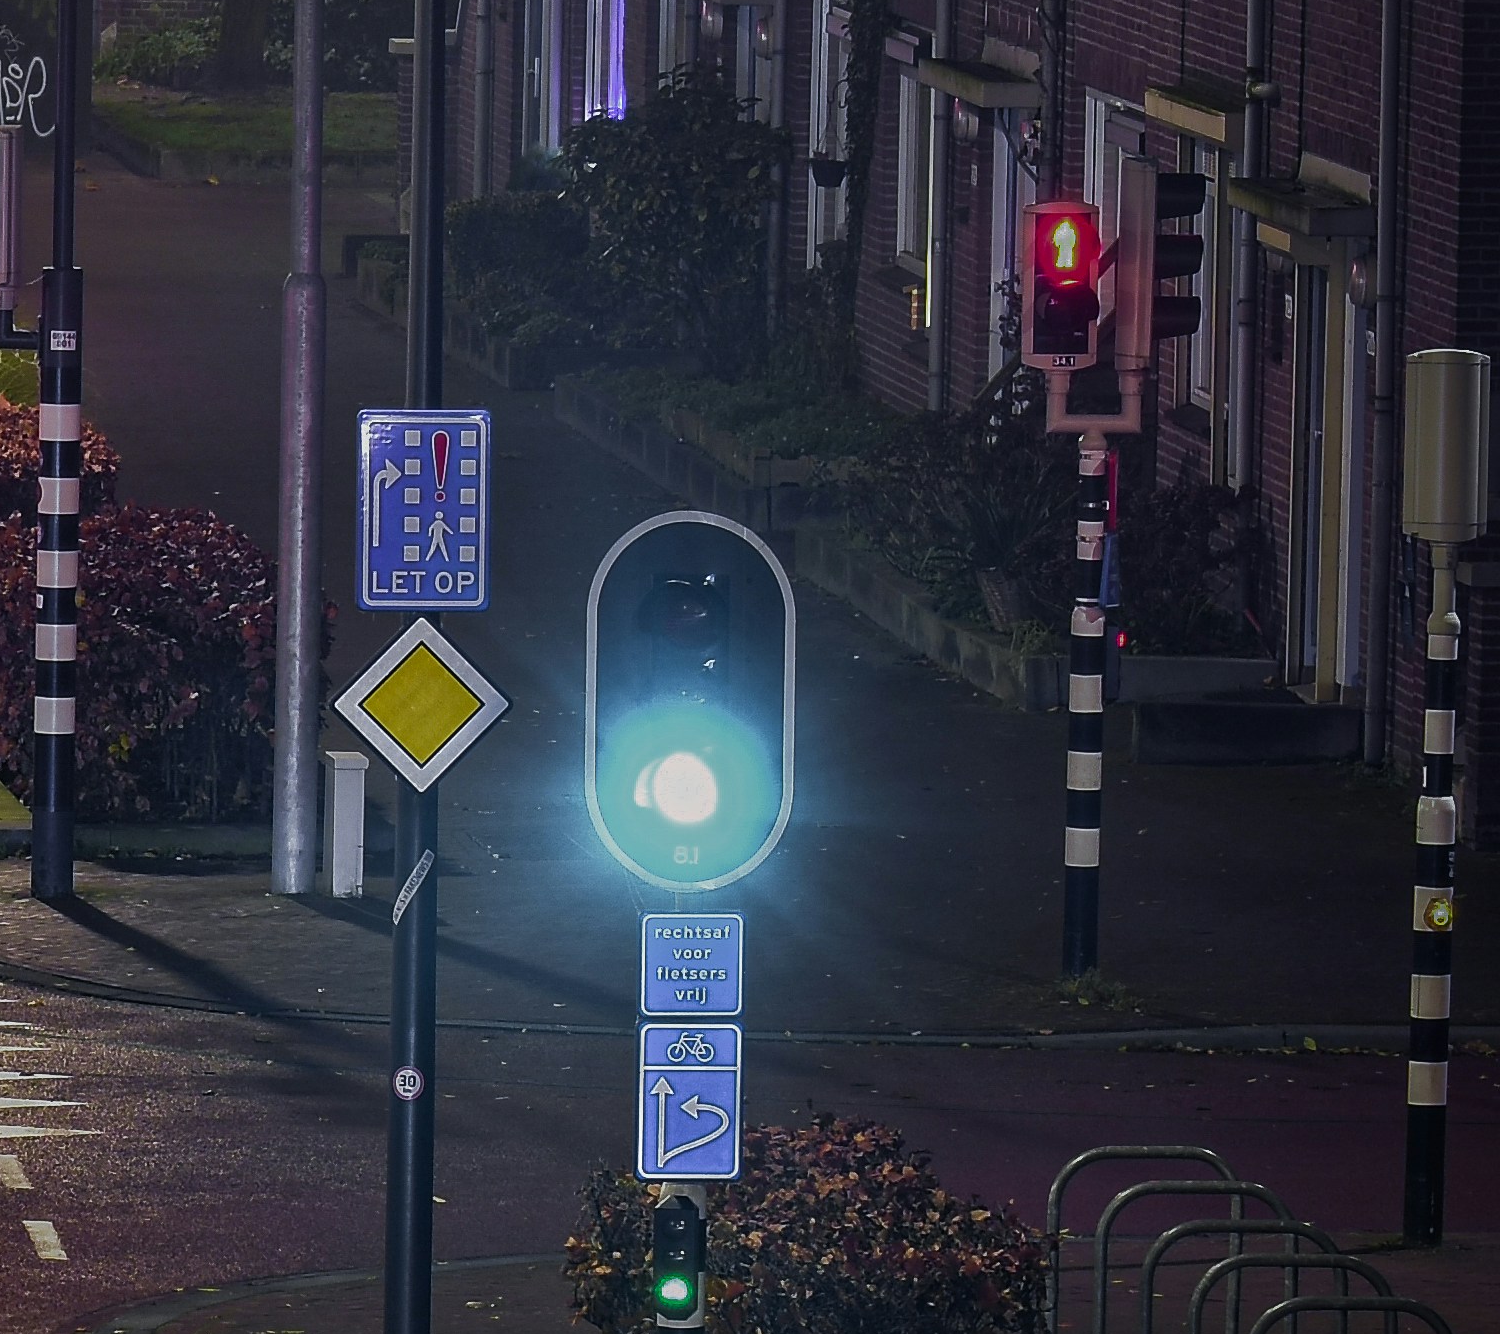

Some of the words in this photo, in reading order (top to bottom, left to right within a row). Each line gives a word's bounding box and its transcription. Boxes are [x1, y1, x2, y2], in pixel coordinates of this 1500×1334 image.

[372, 570, 426, 593] LET
[434, 571, 475, 594] OP
[654, 925, 731, 940] rechtsaf
[672, 948, 712, 960] voor
[657, 966, 727, 980] fietsers
[675, 986, 707, 1005] vrij
[398, 1074, 417, 1087] 30
